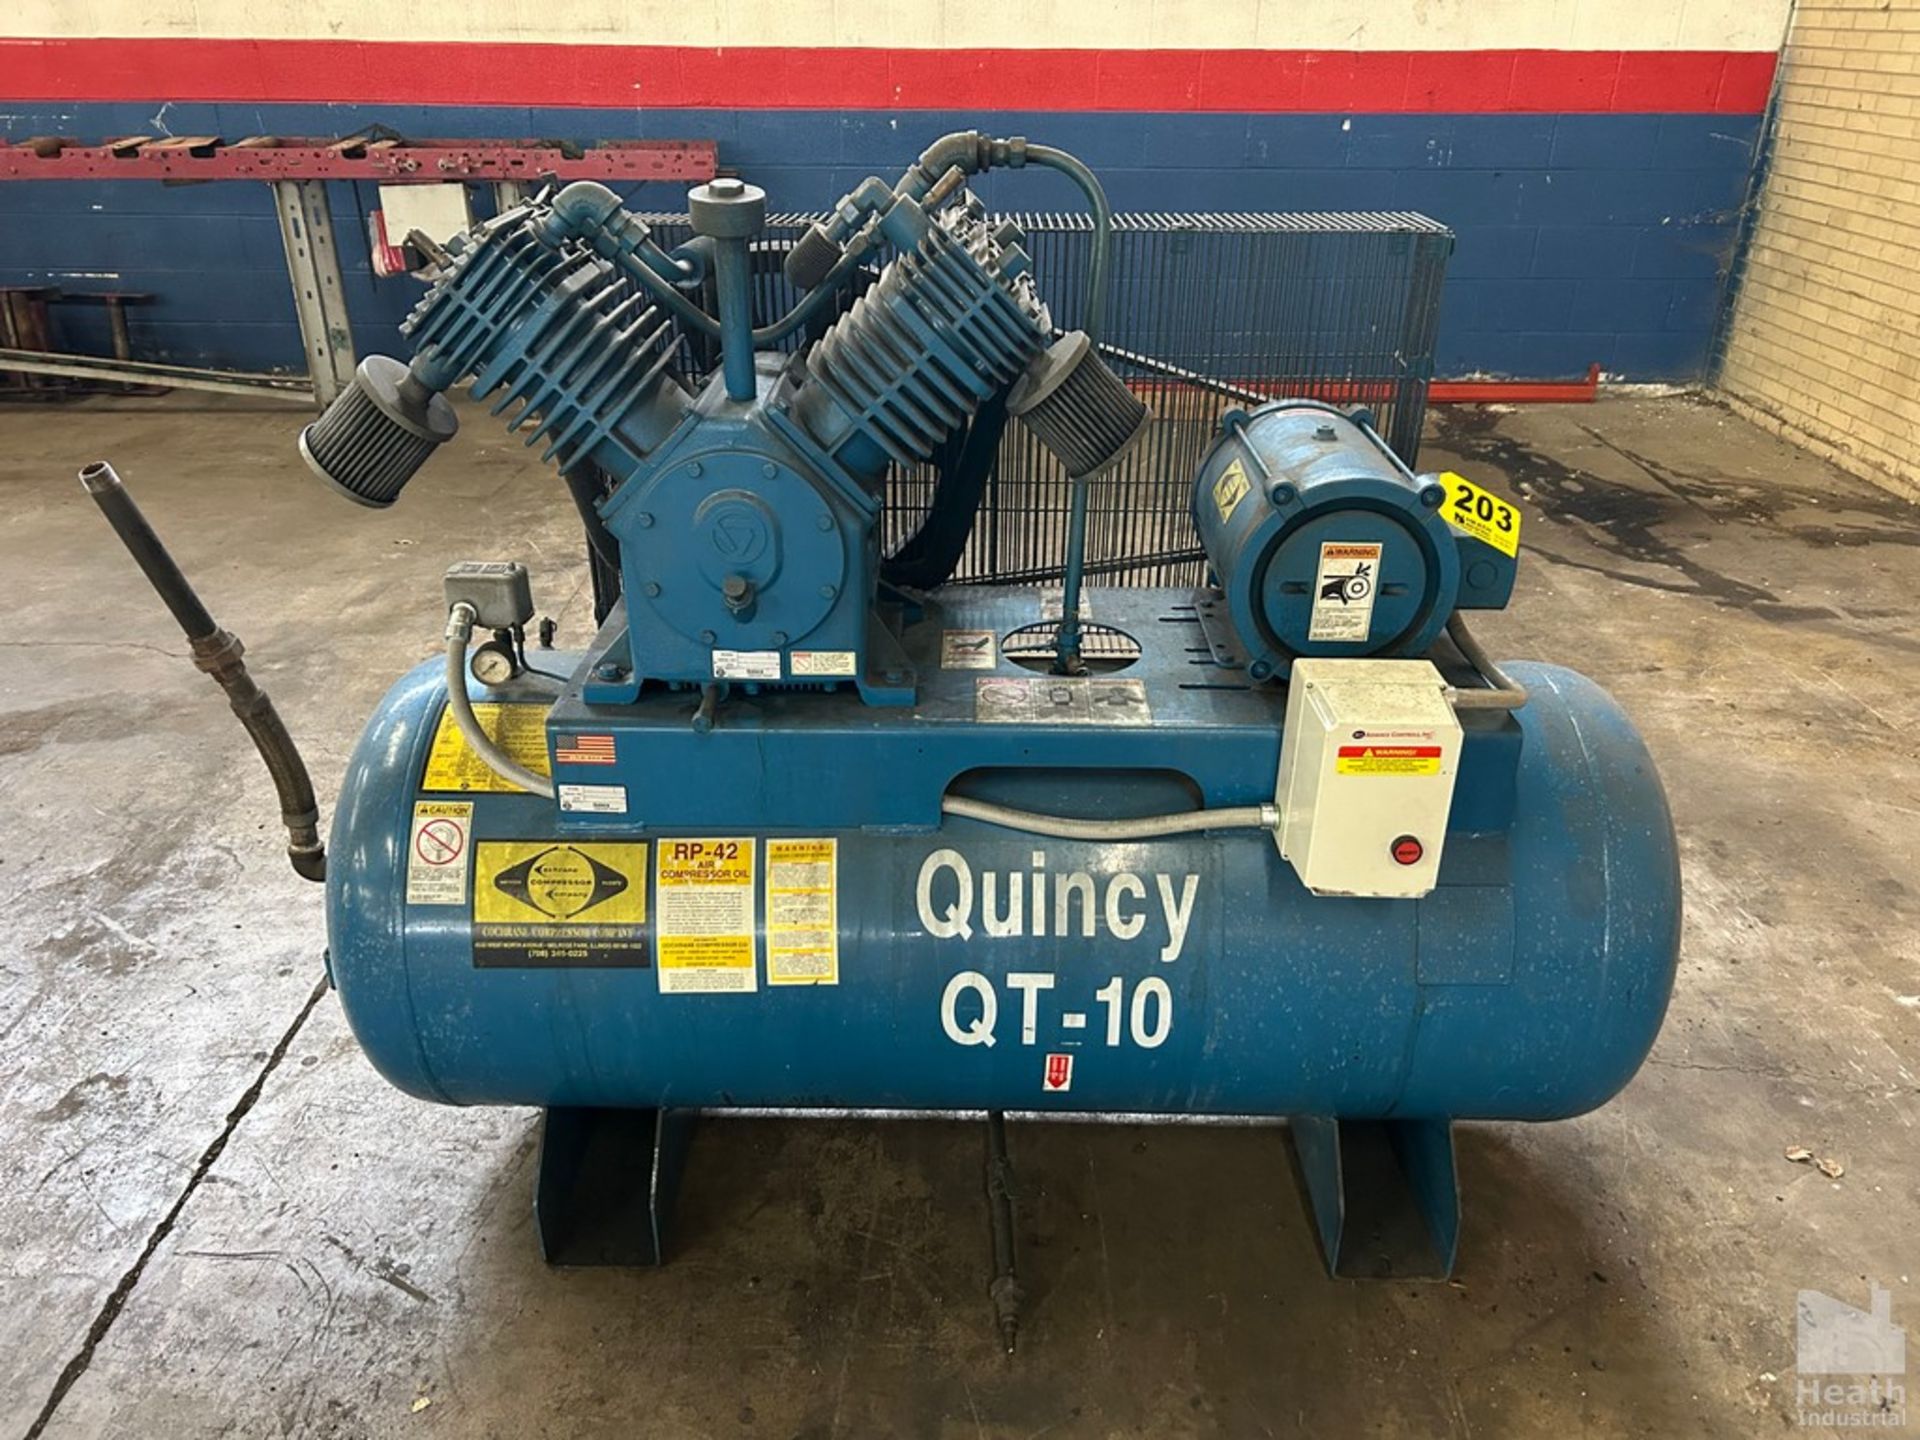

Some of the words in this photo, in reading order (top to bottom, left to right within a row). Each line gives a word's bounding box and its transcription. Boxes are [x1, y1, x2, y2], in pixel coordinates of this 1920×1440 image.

[1454, 485, 1512, 532] 203
[1335, 548, 1377, 556] WARNING
[429, 804, 469, 815] CAUTION
[675, 843, 738, 860] RP-42
[697, 861, 715, 869] AIR
[661, 869, 731, 879] COMPRESSOR
[733, 869, 750, 878] OIL
[916, 848, 1200, 963] Quincy
[940, 971, 1173, 1049] QT-10
